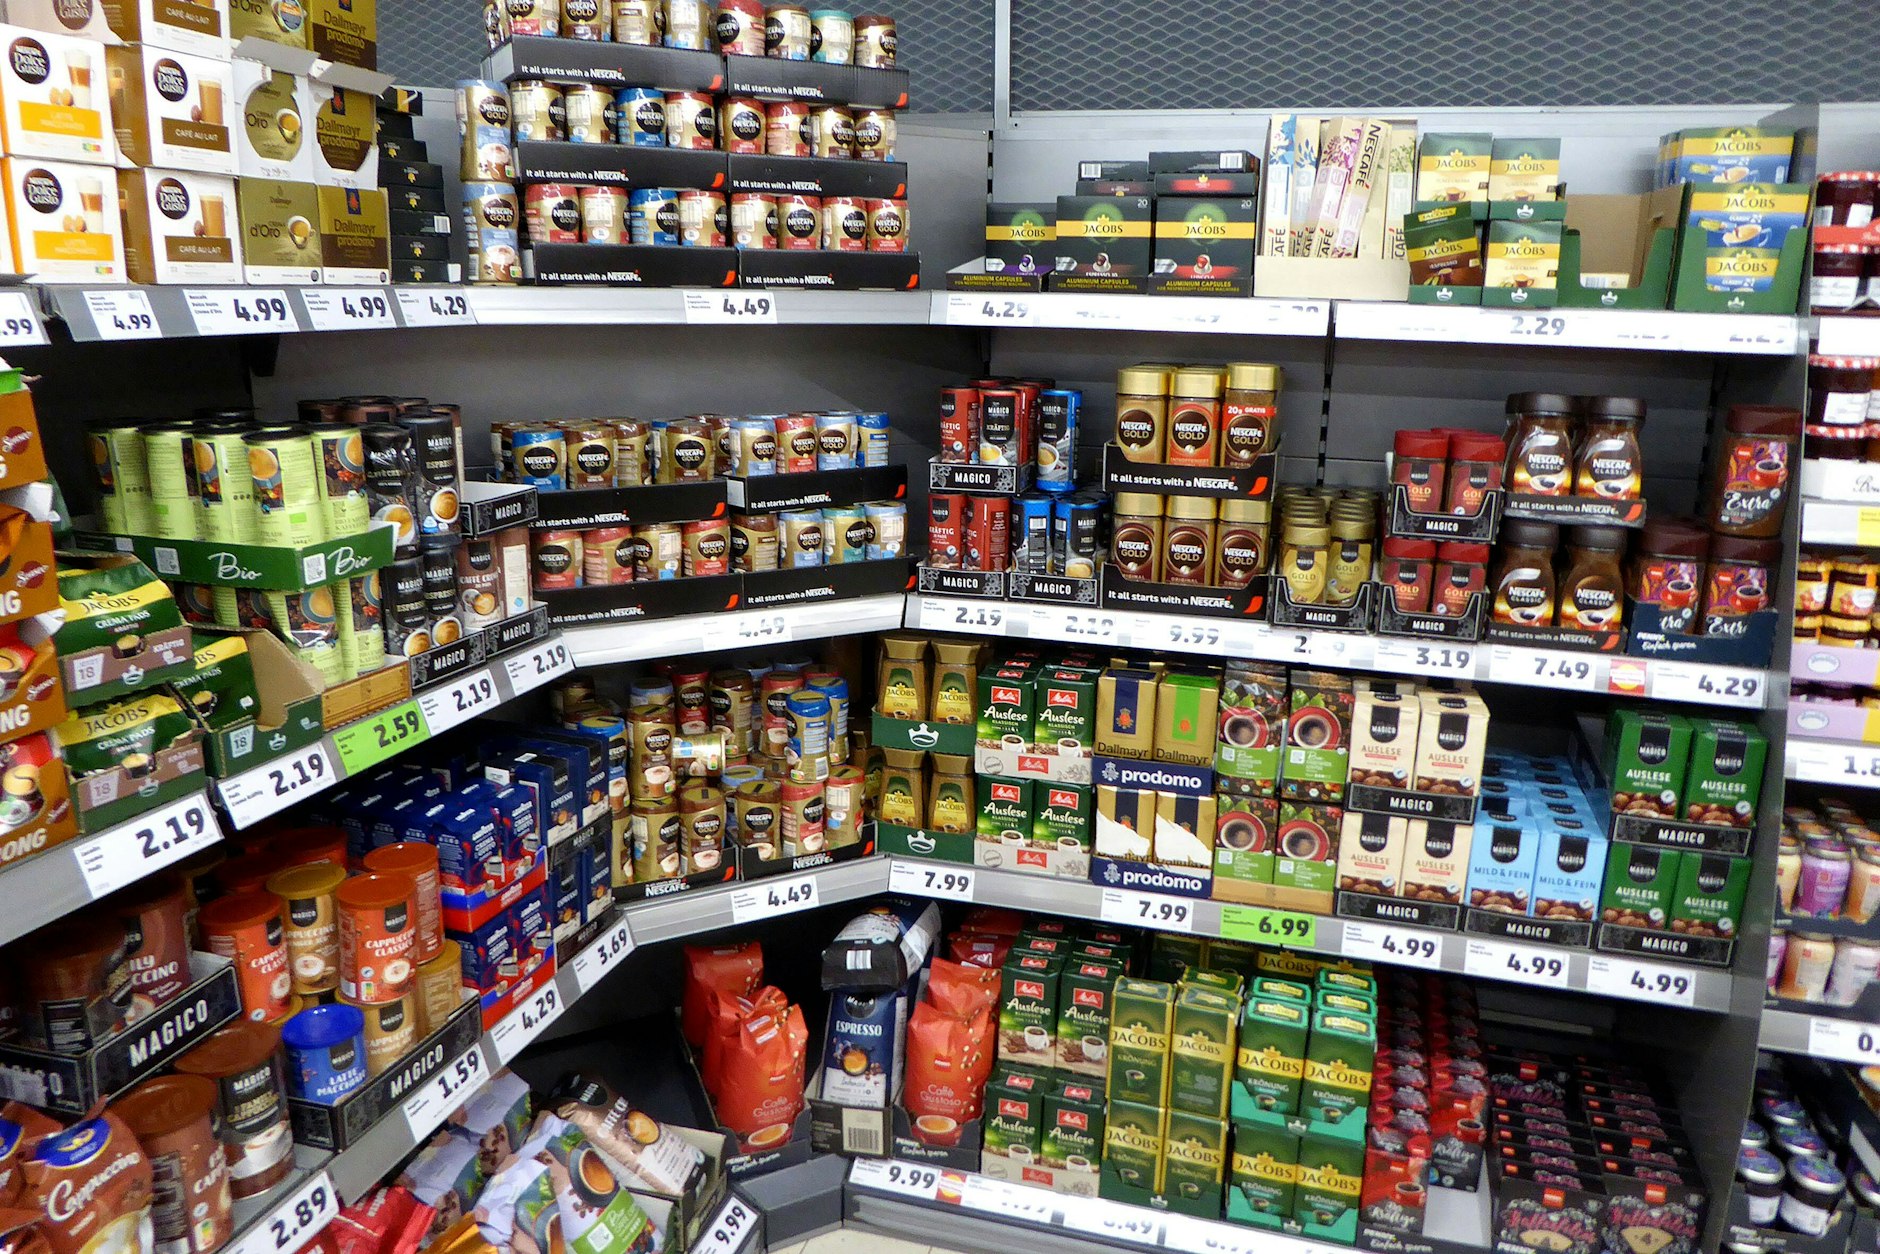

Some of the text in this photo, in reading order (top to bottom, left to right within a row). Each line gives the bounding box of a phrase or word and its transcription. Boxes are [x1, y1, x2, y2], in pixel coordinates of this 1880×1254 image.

[569, 9, 595, 18] GOLD
[323, 11, 367, 36] Dallmayr
[326, 28, 365, 50] prodomo
[521, 65, 528, 73] It
[529, 66, 541, 74] all
[541, 67, 564, 76] starts
[565, 68, 583, 77] with
[486, 110, 509, 120] GOLD
[316, 117, 361, 138] Dallmayr
[1713, 141, 1762, 152] JACOBS
[1435, 157, 1477, 169] JACOBS
[1505, 162, 1545, 172] JACOBS
[1723, 197, 1775, 209] JACOBS
[334, 218, 376, 235] Dallmayr
[1010, 228, 1046, 239] JACOBS
[1083, 223, 1123, 235] JACOBS
[1184, 225, 1226, 236] JACOBS
[1422, 243, 1463, 258] JACOBS
[1504, 245, 1546, 256] JACOBS
[1715, 261, 1767, 272] JACOBS
[995, 276, 1023, 284] CAPSULES
[1066, 277, 1100, 286] ALUMINIUM
[1101, 278, 1129, 287] CAPSULES
[233, 297, 287, 322] 4.99
[342, 296, 387, 318] 4.99
[428, 295, 468, 316] 4.29
[723, 298, 770, 315] 4.49
[981, 301, 1029, 318] 4.29
[113, 313, 152, 330] 4.99
[1510, 315, 1565, 336] 2.29
[1244, 406, 1266, 414] GRATIS
[1123, 429, 1150, 440] GOLD
[1177, 430, 1205, 441] GOLD
[1232, 435, 1260, 445] GOLD
[530, 462, 551, 470] GOLD
[1530, 462, 1562, 471] CLASSIC
[1594, 466, 1629, 476] CLASSIC
[954, 471, 991, 485] MAGICO
[1110, 472, 1119, 482] It
[1119, 473, 1132, 483] all
[1133, 474, 1161, 486] starts
[1162, 475, 1184, 487] with
[1723, 490, 1773, 513] Extra
[495, 503, 522, 520] MAGICO
[1425, 520, 1459, 533] MAGICO
[327, 545, 373, 576] Bio
[1121, 548, 1147, 559] GOLD
[1173, 551, 1200, 562] GOLD
[1226, 556, 1254, 566] GOLD
[208, 552, 263, 581] Bio
[943, 577, 979, 590] MAGICO
[1034, 582, 1072, 595] MAGICO
[80, 594, 142, 615] JACOBS
[1510, 594, 1542, 604] CLASSIC
[1578, 597, 1611, 607] CLASSIC
[95, 615, 127, 630] CREMA
[954, 606, 1002, 627] 2.19
[1305, 612, 1337, 624] MAGICO
[503, 621, 531, 642] MAGICO
[1412, 620, 1445, 633] MAGICO
[433, 648, 466, 672] MAGICO
[533, 645, 567, 675] 2.19
[1415, 647, 1470, 669] 3.19
[78, 666, 94, 680] 18
[1534, 657, 1590, 680] 7.49
[887, 686, 916, 698] JACOBS
[1698, 674, 1758, 697] 4.29
[452, 678, 492, 712] 2.19
[938, 692, 969, 703] JACOBS
[85, 704, 150, 737] JACOBS
[983, 706, 1028, 723] Auslese
[1039, 708, 1085, 726] Auslese
[373, 709, 420, 748] 2.59
[232, 736, 248, 750] 18
[1097, 741, 1149, 759] Dallmayr
[1360, 744, 1402, 757] AUSLESE
[1638, 746, 1667, 757] MAGICO
[1155, 747, 1209, 766] Dallmayr
[1428, 753, 1470, 764] AUSLESE
[268, 753, 325, 797] 2.19
[1121, 768, 1202, 790] prodomo
[1625, 768, 1672, 783] AUSLESE
[1700, 780, 1748, 793] AUSLESE
[983, 801, 1028, 819] Auslese
[1389, 796, 1434, 812] MAGICO
[1040, 807, 1085, 826] Auslese
[135, 806, 205, 859] 2.19
[1657, 828, 1706, 845] MAGICO
[924, 871, 970, 893] 7.99
[1122, 868, 1203, 892] prodomo
[1474, 867, 1531, 880] MILD & FEIN
[1539, 875, 1597, 890] MILD & FEIN
[767, 883, 813, 908] 4.49
[1614, 885, 1660, 900] AUSLESE
[1138, 900, 1188, 923] 7.99
[1376, 903, 1420, 920] MAGICO
[1683, 896, 1730, 911] AUSLESE
[1258, 916, 1311, 938] 6.99
[1505, 922, 1551, 938] MAGICO
[597, 928, 628, 966] 3.69
[1382, 934, 1436, 958] 4.99
[1641, 936, 1688, 954] MAGICO
[1506, 952, 1563, 977] 4.99
[1630, 969, 1688, 996] 4.99
[521, 989, 557, 1030] 4.29
[1006, 998, 1051, 1016] Auslese
[1064, 1005, 1110, 1025] Auslese
[128, 999, 209, 1068] MAGICO
[835, 1020, 883, 1037] ESPRESSO
[1112, 1029, 1167, 1050] JACOBS
[1178, 1039, 1221, 1056] JACOBS
[390, 1044, 444, 1099] MAGICO
[1242, 1054, 1300, 1074] JACOBS
[437, 1050, 479, 1100] 1.59
[1306, 1064, 1369, 1087] JACOBS
[991, 1116, 1036, 1135] Auslese
[1049, 1126, 1095, 1146] Auslese
[1106, 1128, 1159, 1152] JACOBS
[1167, 1143, 1221, 1164] JACOBS
[888, 1165, 936, 1189] 9.99
[1236, 1160, 1294, 1180] JACOBS
[1299, 1171, 1359, 1193] JACOBS
[271, 1186, 328, 1250] 2.89
[714, 1204, 748, 1246] 9.99
